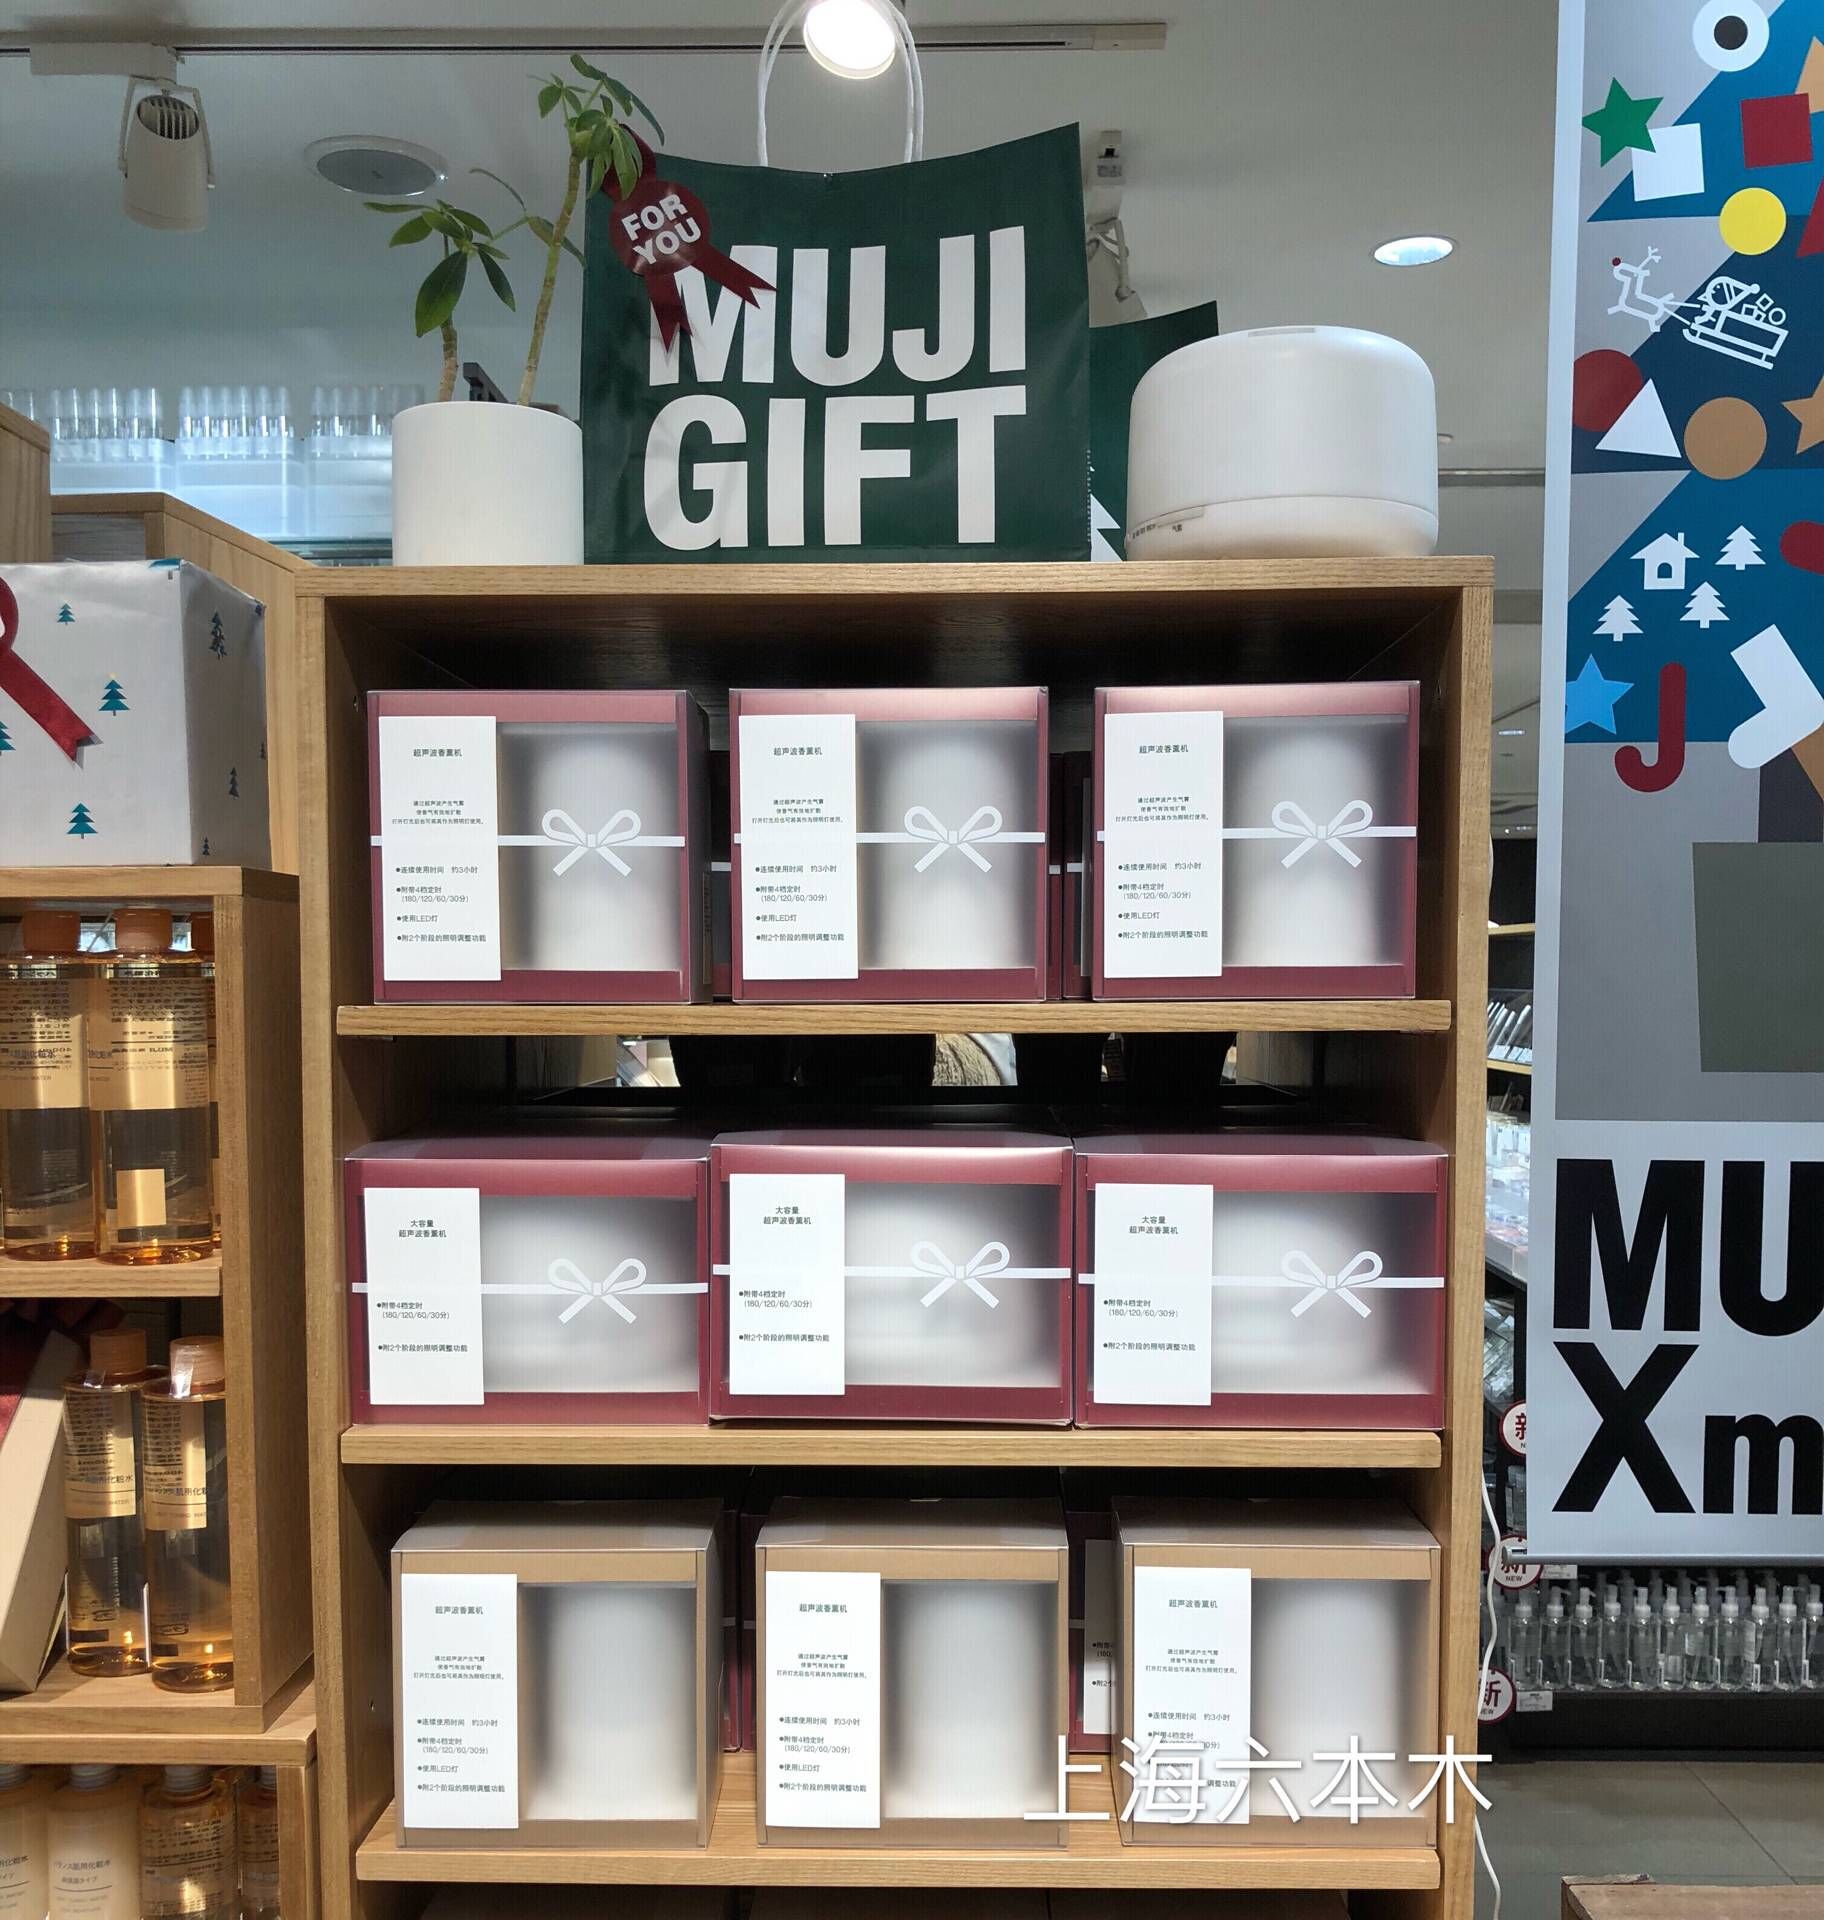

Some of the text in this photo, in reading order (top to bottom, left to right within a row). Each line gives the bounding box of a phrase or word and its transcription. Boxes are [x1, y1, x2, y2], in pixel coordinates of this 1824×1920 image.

[622, 193, 688, 241] FOR
[633, 217, 701, 264] YOU
[649, 225, 1026, 387] MUJI
[643, 385, 1027, 551] GIFT
[400, 865, 479, 874] 连续使用时间 约3小时
[759, 864, 838, 874] 连续使用时间 约3小时
[1122, 861, 1202, 872] 连续使用时间 约3小时
[400, 885, 442, 894] 附带4档定时
[759, 884, 801, 894] 附带4档定时
[1122, 882, 1165, 892] 附带4档定时
[401, 894, 469, 904] (180/120/60/30分)
[760, 893, 828, 903] (180/120/60/30分)
[1123, 890, 1192, 901] (180/120/60/30分)
[401, 914, 439, 923] 使用LED灯
[760, 914, 798, 923] 使用LED灯
[1122, 911, 1161, 920] 使用LED灯
[401, 933, 487, 943] 附2个阶段的照明调整功能
[759, 932, 845, 942] 附2个阶段的照明调整功能
[1121, 930, 1209, 940] 附2个阶段的照明调整功能
[775, 1206, 800, 1215] 大容量
[410, 1219, 435, 1229] 大容量
[1141, 1215, 1166, 1225] 大容量
[1553, 1158, 1824, 1337] MU
[743, 1289, 786, 1299] 附带4档定时
[380, 1301, 423, 1310] 附带4档定时
[743, 1299, 813, 1309] (180/120/60/30分)
[1107, 1298, 1152, 1308] 附带4档定时
[382, 1311, 450, 1320] (180/120/60/30分)
[1108, 1308, 1178, 1318] (180/120/60/30分)
[743, 1333, 830, 1342] 附2个阶段的照明调整功能
[381, 1343, 469, 1353] 附2个阶段的照明调整功能
[1107, 1341, 1196, 1352] 附2个阶段的照明调整功能
[1552, 1341, 1824, 1515] Xm
[783, 1716, 861, 1726] 连续使用时间 约3小时
[1153, 1712, 1197, 1720] 连续使用时间
[421, 1718, 499, 1728] 连续使用时间 约3小时
[421, 1737, 463, 1746] 附带4档定时
[783, 1735, 825, 1745] 附带4档定时
[422, 1746, 489, 1755] (180/120/60/30分)
[784, 1744, 851, 1754] (180/120/60/30分)
[421, 1764, 459, 1773] 使用LED灯
[783, 1763, 821, 1773] 使用LED灯
[421, 1783, 506, 1793] 附2个阶段的照明调整功能
[783, 1782, 867, 1793] 附2个阶段的照明调整功能
